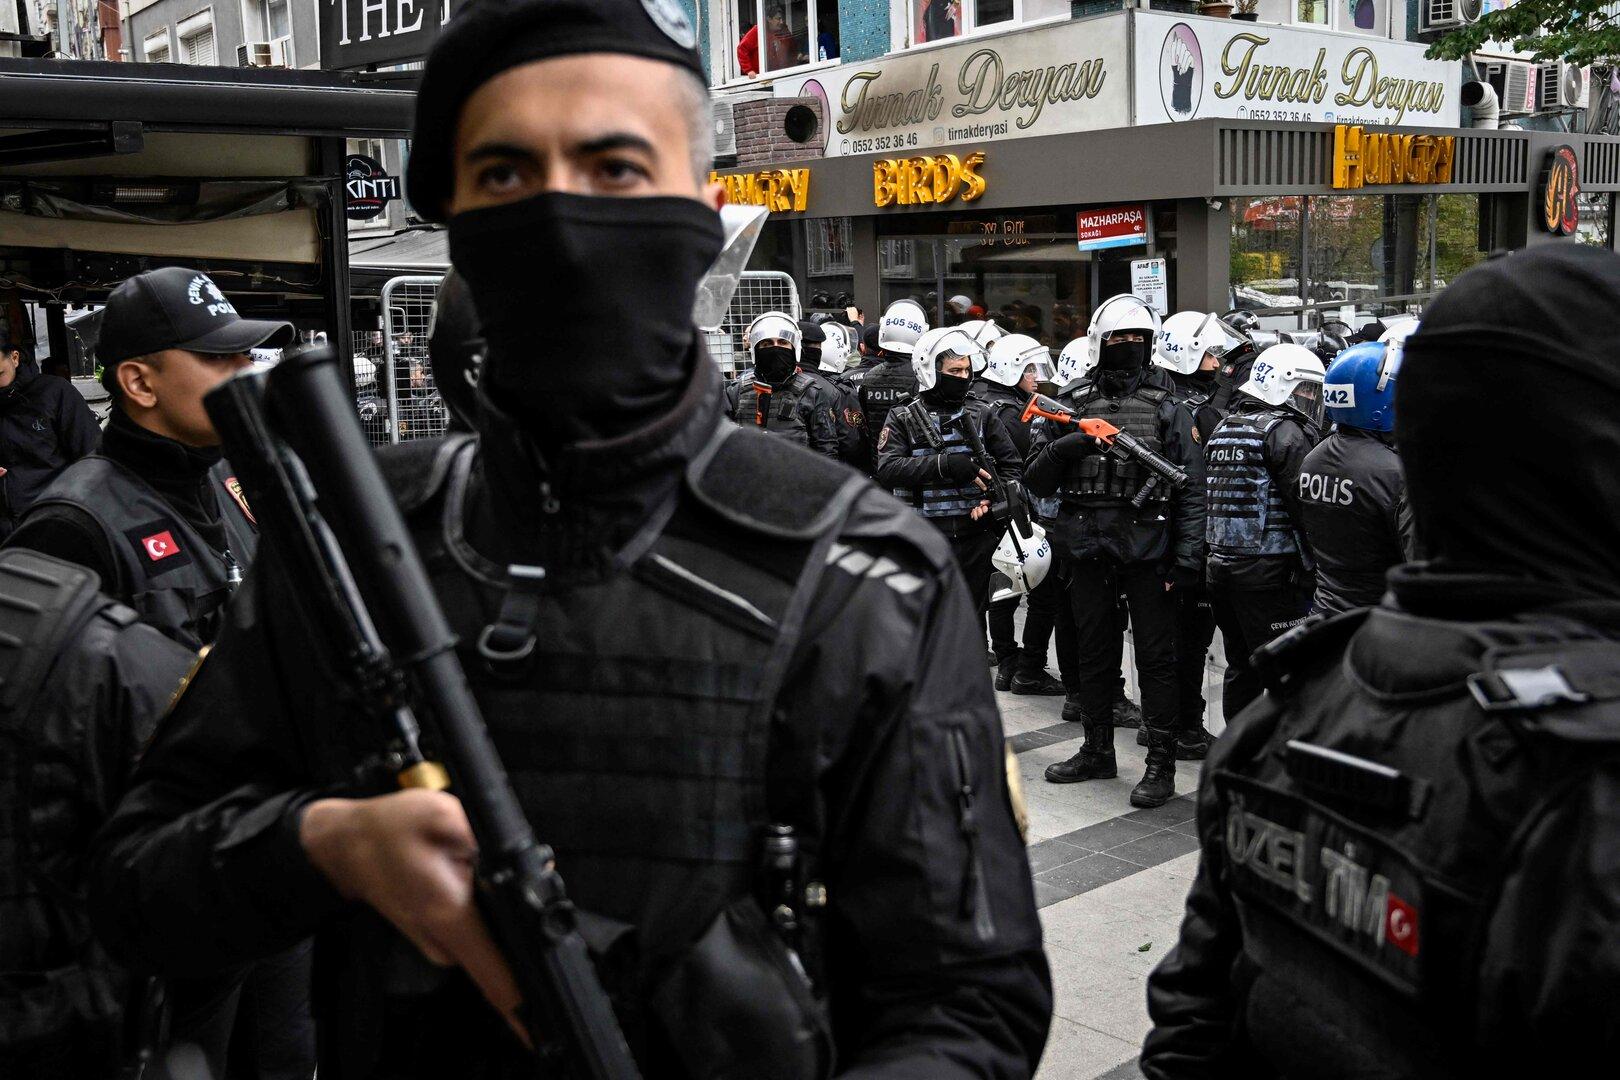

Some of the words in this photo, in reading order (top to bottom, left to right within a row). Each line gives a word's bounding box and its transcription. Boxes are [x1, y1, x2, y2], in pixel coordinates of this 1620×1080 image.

[331, 0, 424, 45] THE
[1250, 110, 1271, 121] 0552
[1273, 111, 1287, 121] 352
[1289, 112, 1300, 122] 36
[948, 120, 1008, 141] tirnakderyasi
[852, 139, 873, 153] 0552
[875, 136, 891, 150] 352
[894, 134, 904, 148] 36
[907, 132, 918, 146] 46
[874, 152, 986, 207] BIRDS
[708, 168, 811, 212] UNGRY
[1080, 210, 1143, 229] MAZHARPAŞA
[1166, 343, 1178, 352] 34
[990, 360, 997, 369] 34
[1254, 372, 1266, 384] 34
[1210, 446, 1244, 461] POLİS
